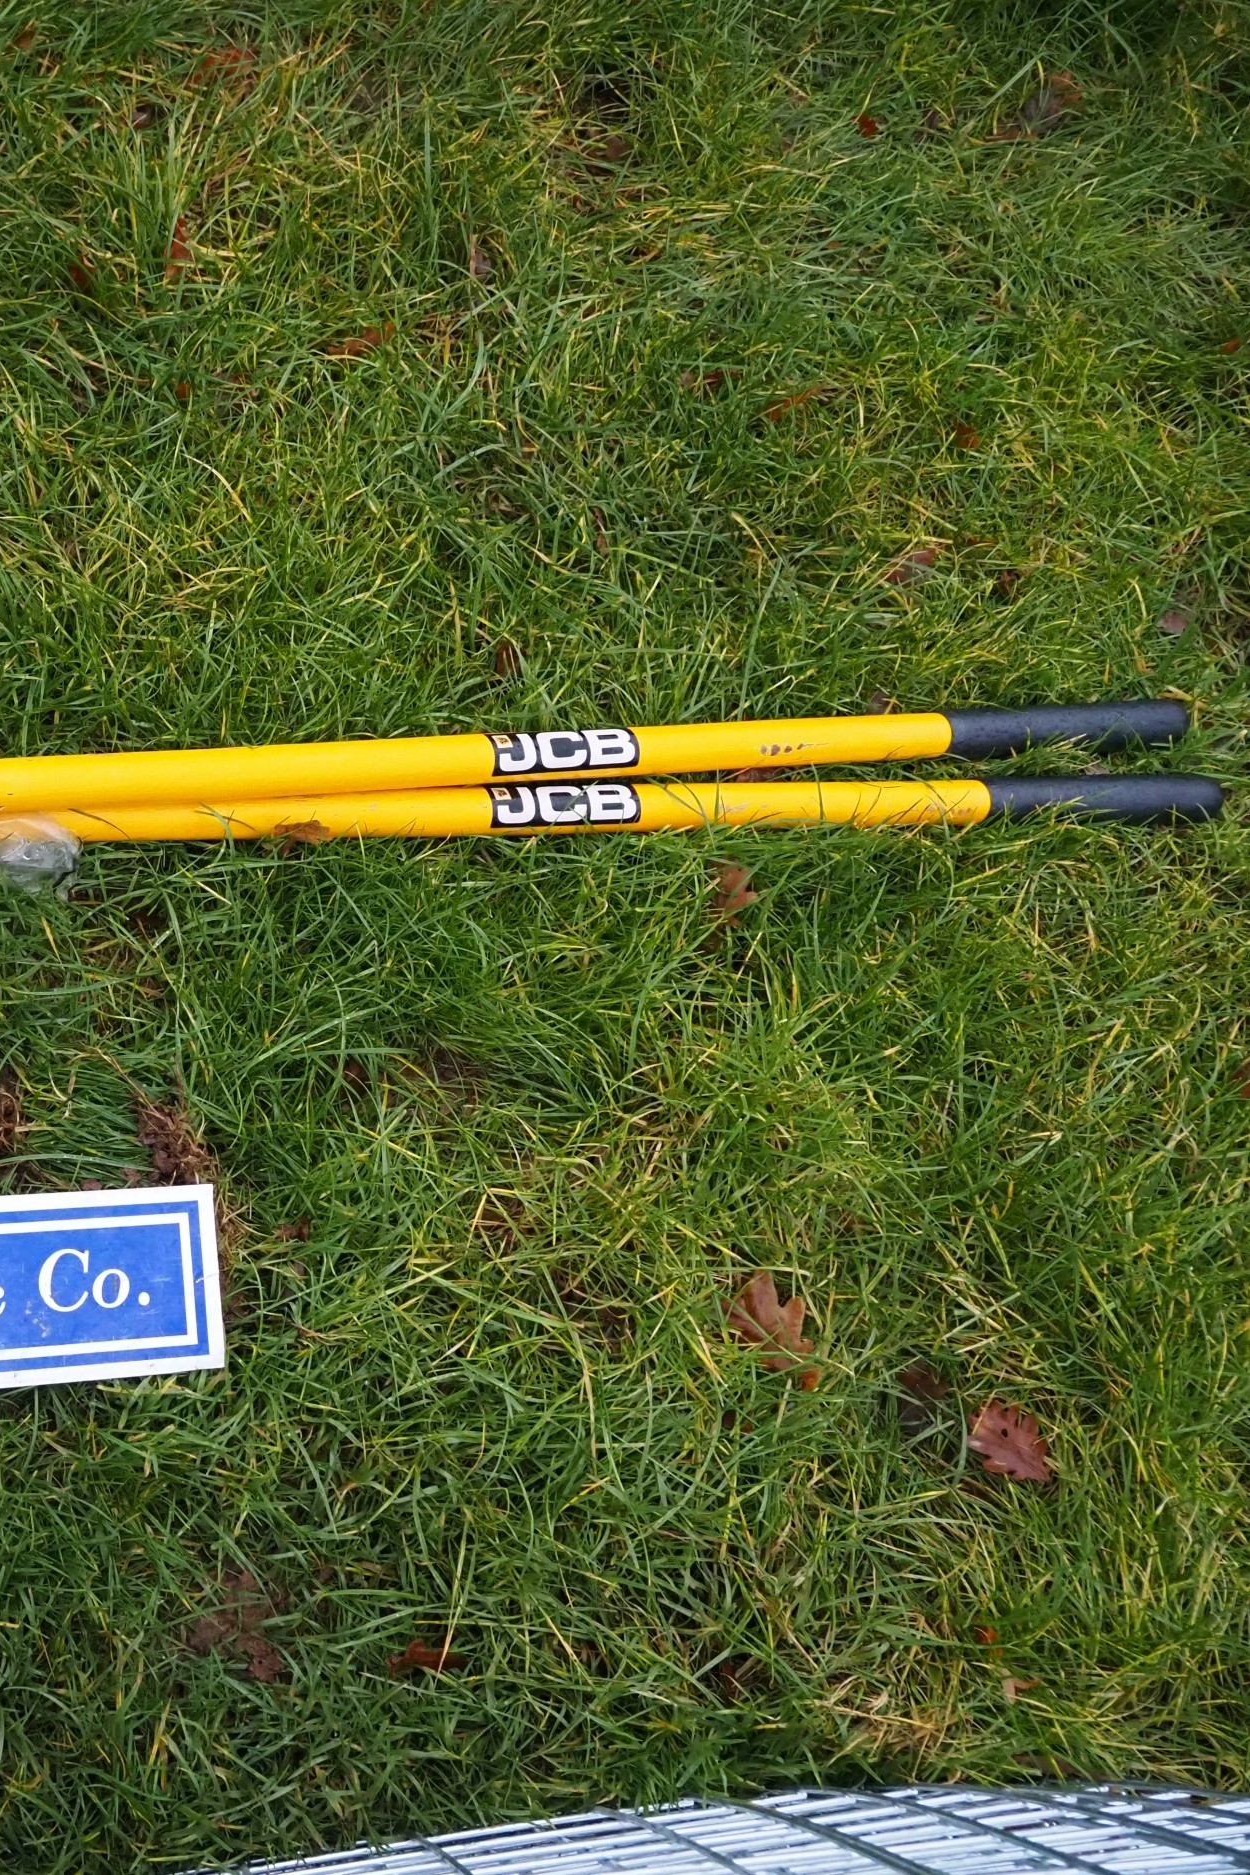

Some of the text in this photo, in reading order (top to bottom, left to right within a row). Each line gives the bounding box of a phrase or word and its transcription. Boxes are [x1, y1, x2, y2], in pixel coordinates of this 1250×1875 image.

[499, 728, 636, 772] JCB
[497, 784, 637, 824] JCB
[38, 1248, 151, 1313] Co.
